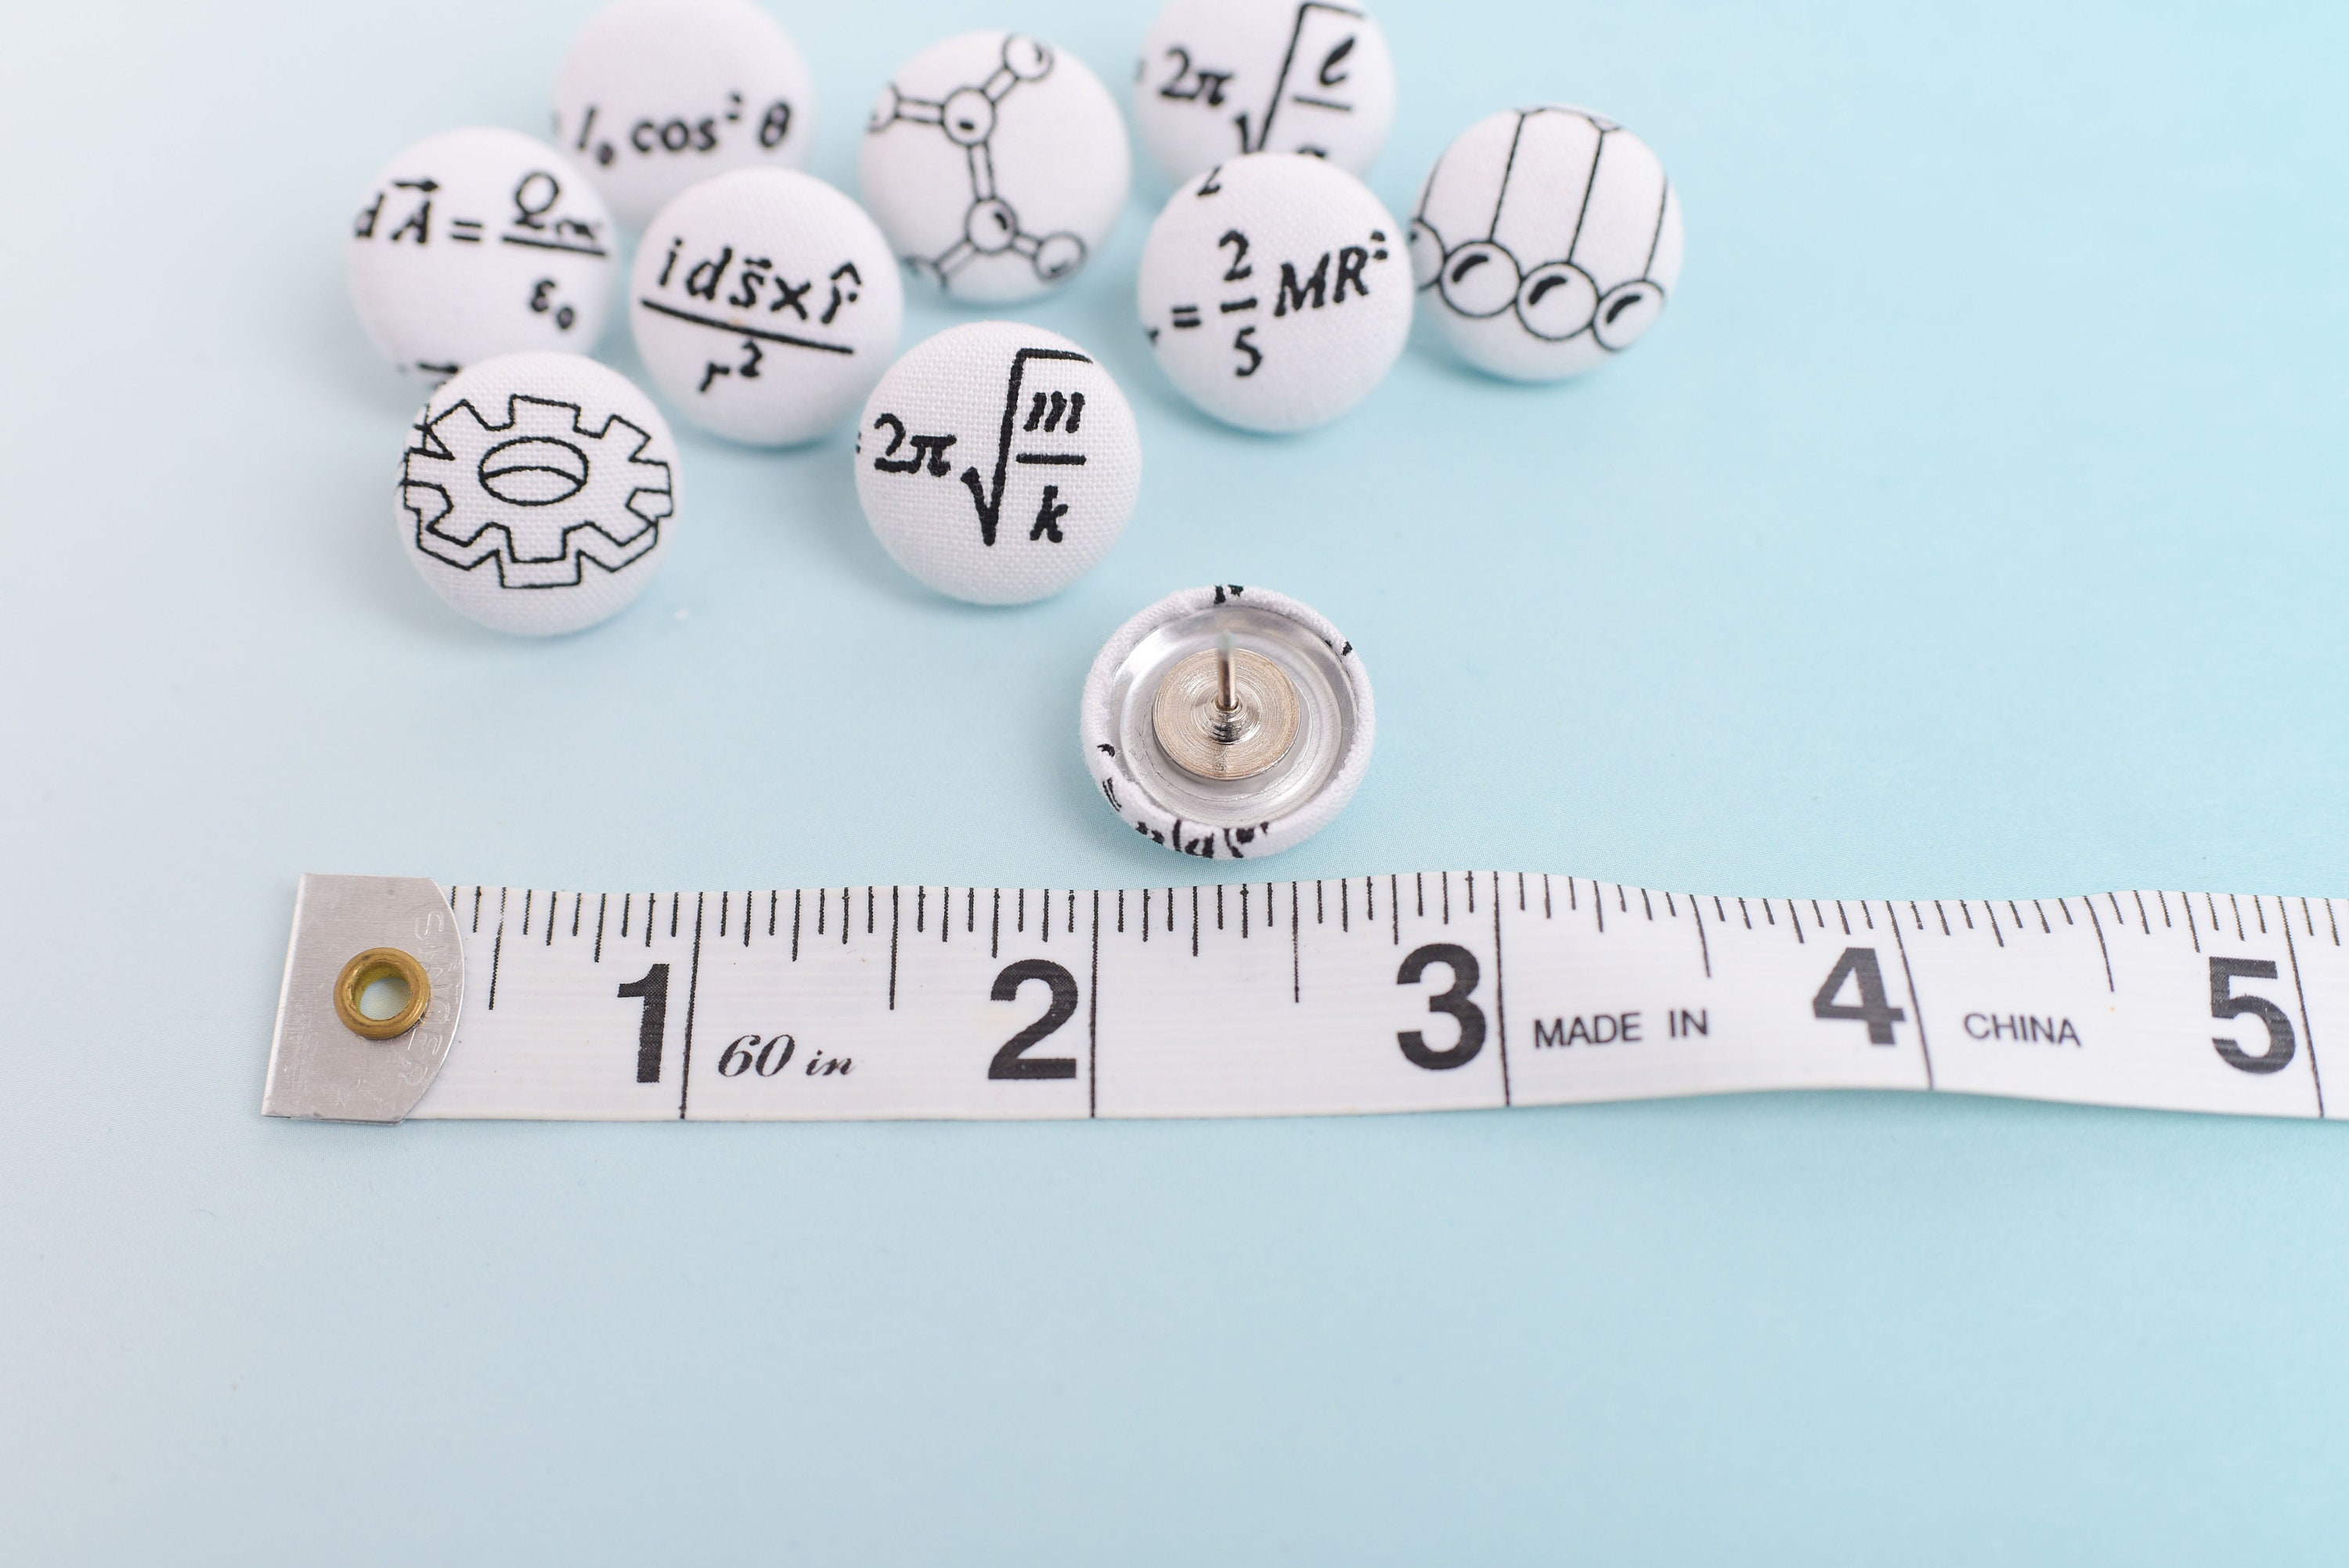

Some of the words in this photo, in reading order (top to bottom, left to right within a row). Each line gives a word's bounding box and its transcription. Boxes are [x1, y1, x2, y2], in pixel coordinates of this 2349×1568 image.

[617, 963, 670, 1083] 1
[987, 958, 1078, 1081] 2
[1396, 943, 1486, 1071] 3
[1533, 1011, 1643, 1048] MADE
[1669, 1009, 1709, 1038] IN
[1812, 946, 1907, 1045] 4
[1962, 1011, 2083, 1048] CHINA
[2208, 956, 2296, 1075] 5
[717, 1034, 794, 1078] 60
[806, 1050, 856, 1076] in
